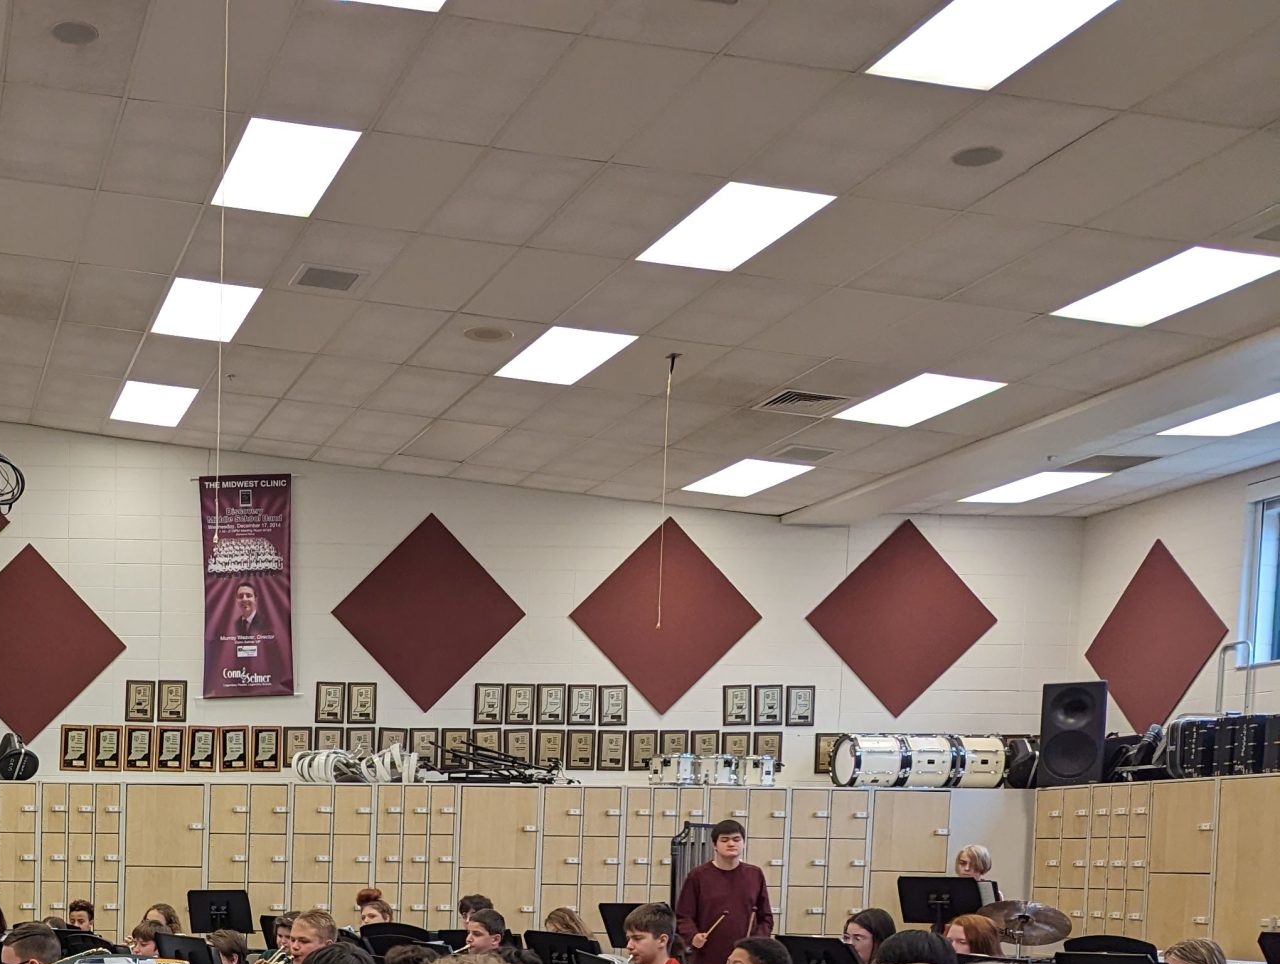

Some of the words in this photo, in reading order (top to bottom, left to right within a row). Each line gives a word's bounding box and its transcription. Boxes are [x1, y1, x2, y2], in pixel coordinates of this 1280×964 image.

[204, 481, 220, 489] THE
[221, 480, 259, 489] MIDWEST
[260, 479, 287, 487] CLINIC
[222, 667, 241, 679] Conn
[246, 672, 271, 684] Selmer
